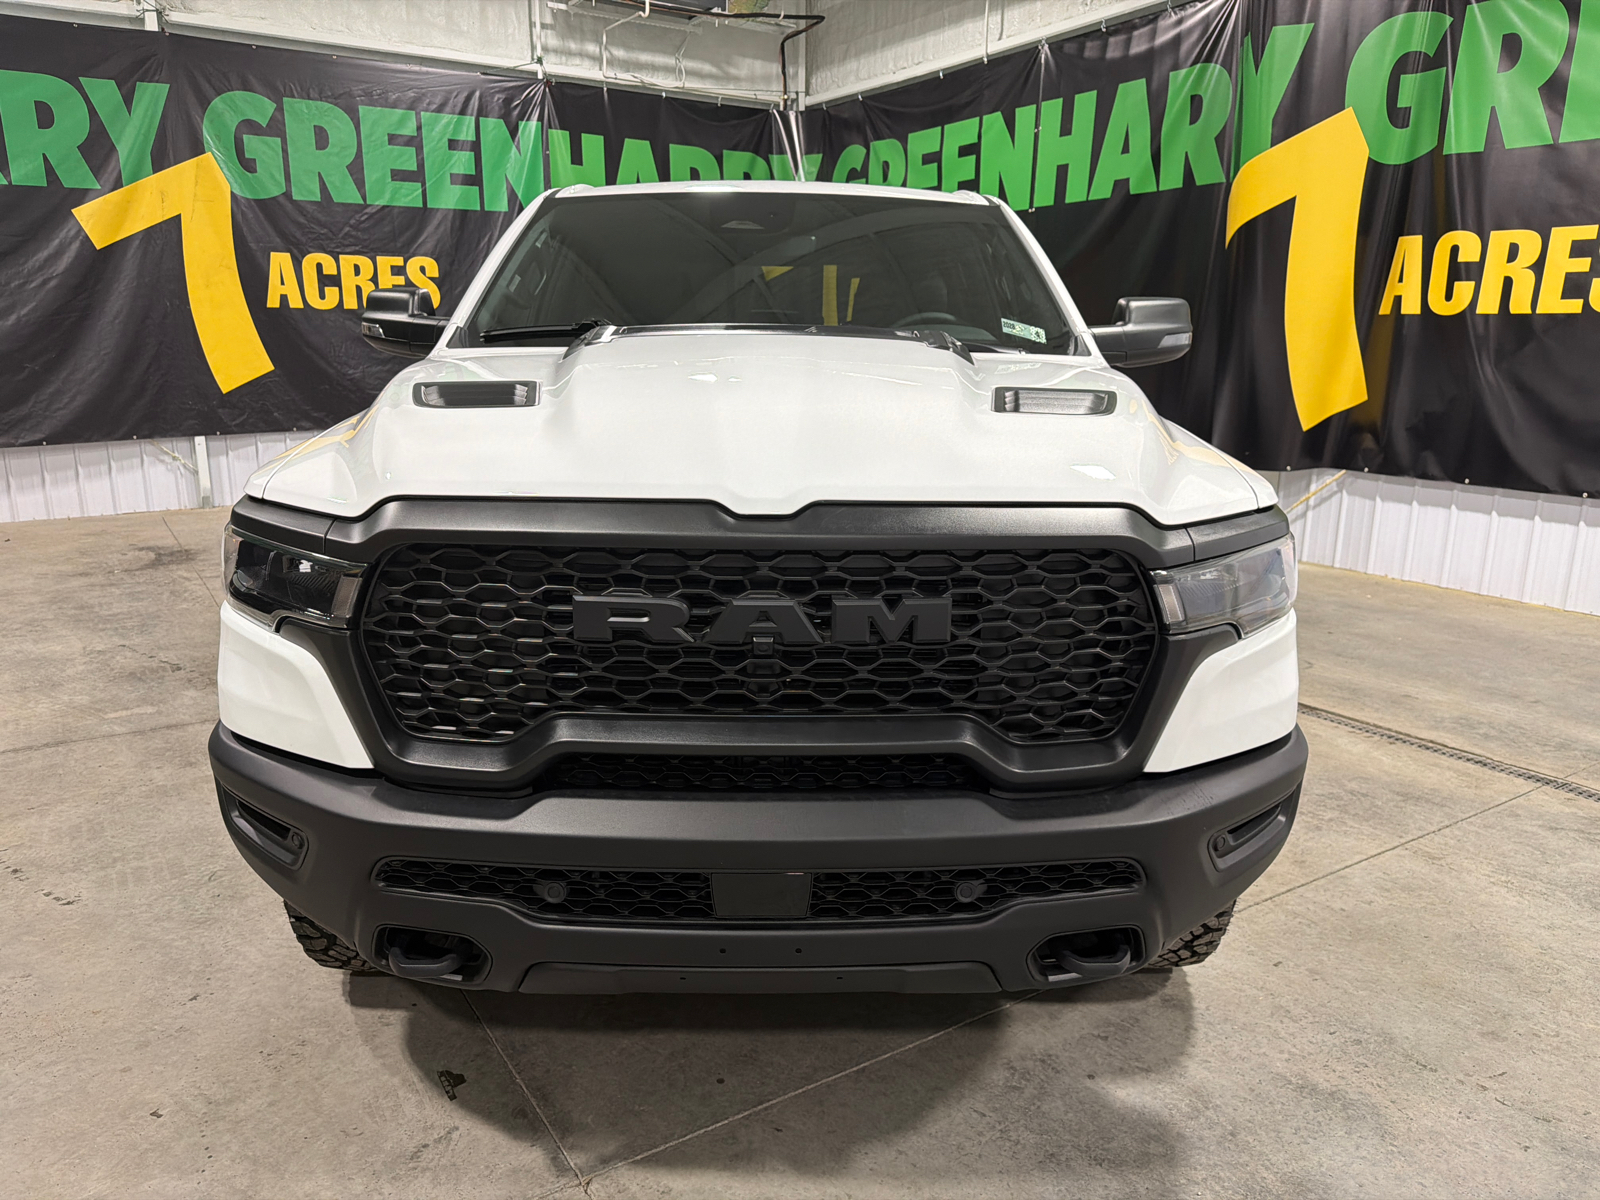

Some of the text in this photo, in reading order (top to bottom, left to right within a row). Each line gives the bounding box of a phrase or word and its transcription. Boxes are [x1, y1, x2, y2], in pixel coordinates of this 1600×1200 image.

[0, 69, 545, 212] RY GREEN
[71, 151, 441, 394] 7 ACRES
[1226, 106, 1600, 432] 7 ACRE
[572, 594, 953, 645] RAM
